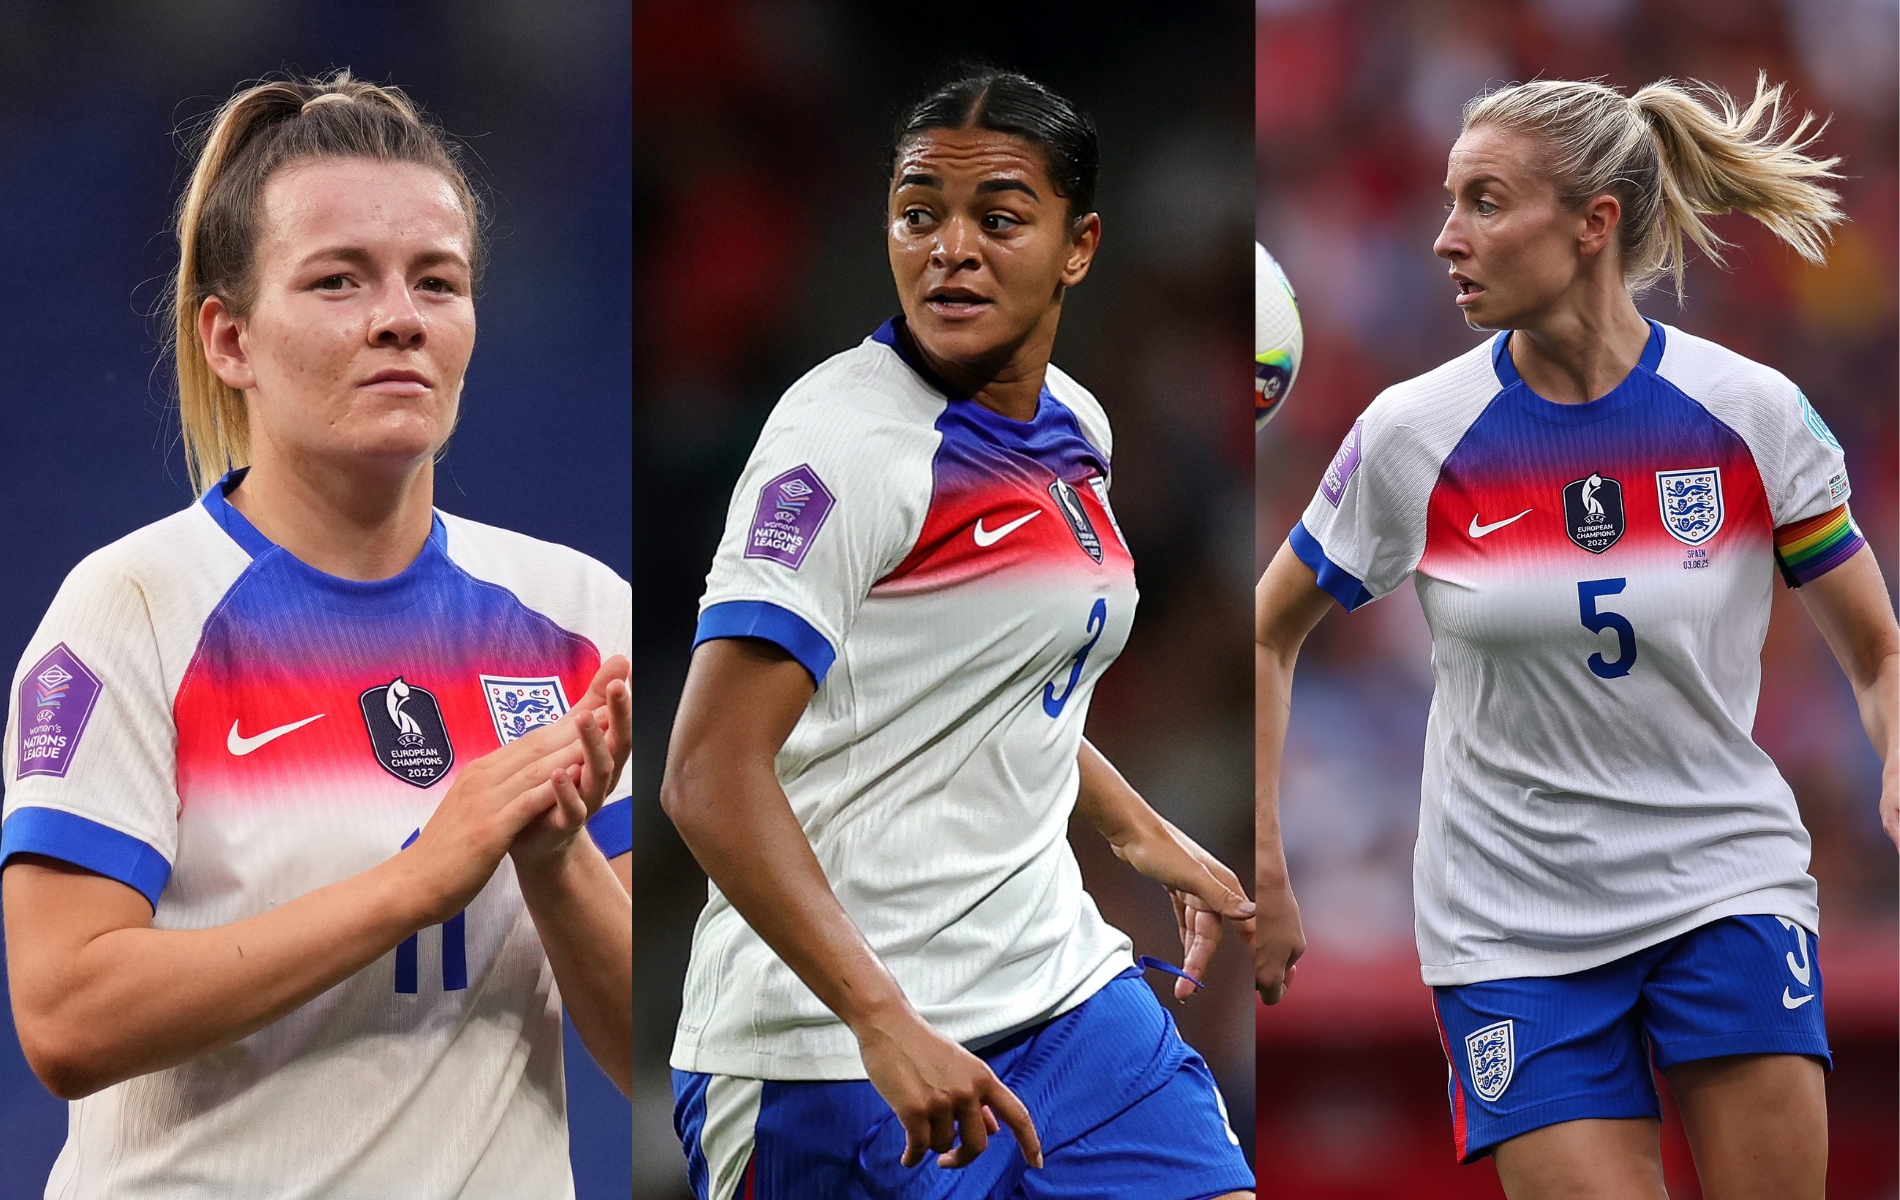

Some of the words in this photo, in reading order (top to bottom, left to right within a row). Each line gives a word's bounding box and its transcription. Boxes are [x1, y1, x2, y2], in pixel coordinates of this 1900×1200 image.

[1577, 523, 1613, 533] EUROPEAN
[754, 528, 804, 547] NATIONS
[1576, 530, 1616, 540] CHAMPIONS
[754, 537, 798, 555] LEAGUE
[1587, 538, 1608, 547] 2022
[1687, 549, 1706, 558] SPAIN
[1683, 559, 1709, 570] 03.06.25
[1577, 577, 1638, 680] 5
[30, 723, 62, 735] women's
[23, 734, 68, 750] NATIONS
[398, 735, 425, 747] UEFA
[23, 746, 61, 762] LEAGUE
[391, 748, 438, 758] EUROPEAN
[391, 757, 443, 767] CHAMPIONS
[407, 767, 435, 778] 2022
